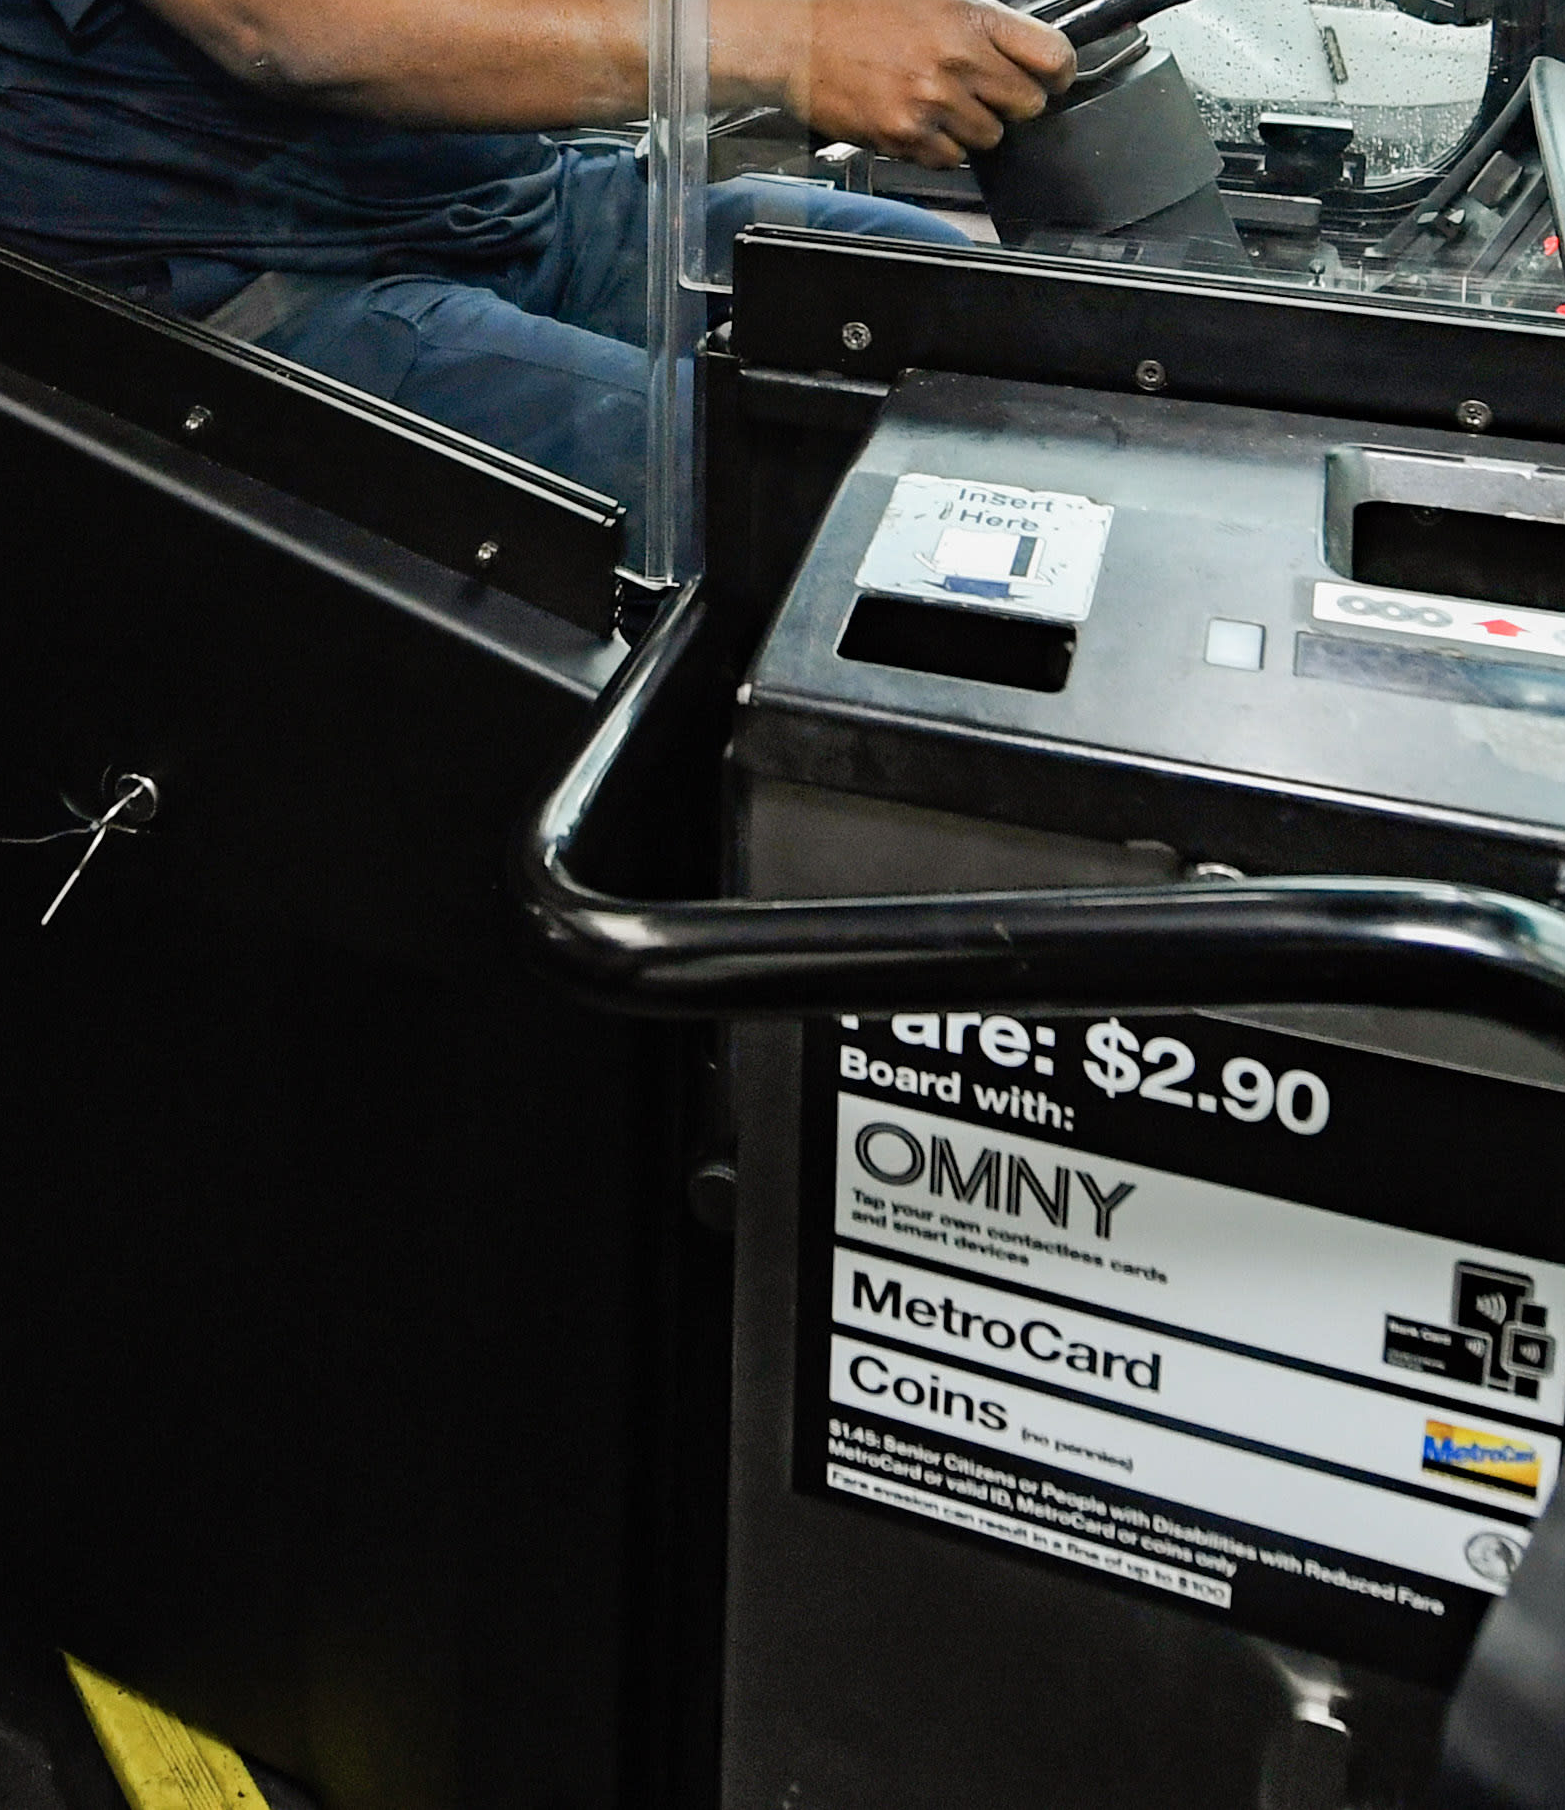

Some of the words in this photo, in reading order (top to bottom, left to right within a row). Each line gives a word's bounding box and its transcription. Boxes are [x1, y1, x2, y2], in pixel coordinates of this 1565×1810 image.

[959, 487, 1054, 513] Insert
[959, 508, 1039, 532] Here
[839, 1044, 962, 1105] Board
[973, 1082, 1076, 1131] with:
[840, 1012, 1057, 1077] are:
[1082, 1016, 1331, 1136] $2.90
[854, 1121, 1137, 1240] OMNY
[851, 1207, 887, 1230] and
[893, 1219, 949, 1246] smart
[953, 1236, 1030, 1267] devices
[853, 1187, 886, 1211] Tap
[891, 1198, 934, 1225] your
[940, 1215, 981, 1235] own
[987, 1226, 1103, 1268] contactless
[1111, 1258, 1168, 1285] cards
[852, 1269, 1163, 1393] MetroCard
[849, 1355, 1010, 1432] Coins
[828, 1438, 922, 1482] MetroCard
[923, 1469, 945, 1488] or
[945, 1473, 987, 1502] valid
[1016, 1493, 1116, 1541] MetroCard
[1116, 1525, 1139, 1547] or
[1140, 1532, 1194, 1565] coins
[1194, 1551, 1237, 1579] only
[883, 1434, 944, 1468] Senior
[944, 1451, 1017, 1490] Citizens
[1019, 1474, 1039, 1494] or
[1041, 1481, 1108, 1518] People
[1109, 1502, 1151, 1531] with
[1152, 1513, 1258, 1562] Disabilities
[1258, 1546, 1303, 1575] with
[1304, 1558, 1396, 1603] Reduced
[1397, 1585, 1446, 1617] Fare
[942, 1502, 975, 1523] can
[1033, 1529, 1049, 1546] in
[1067, 1540, 1100, 1564] fine
